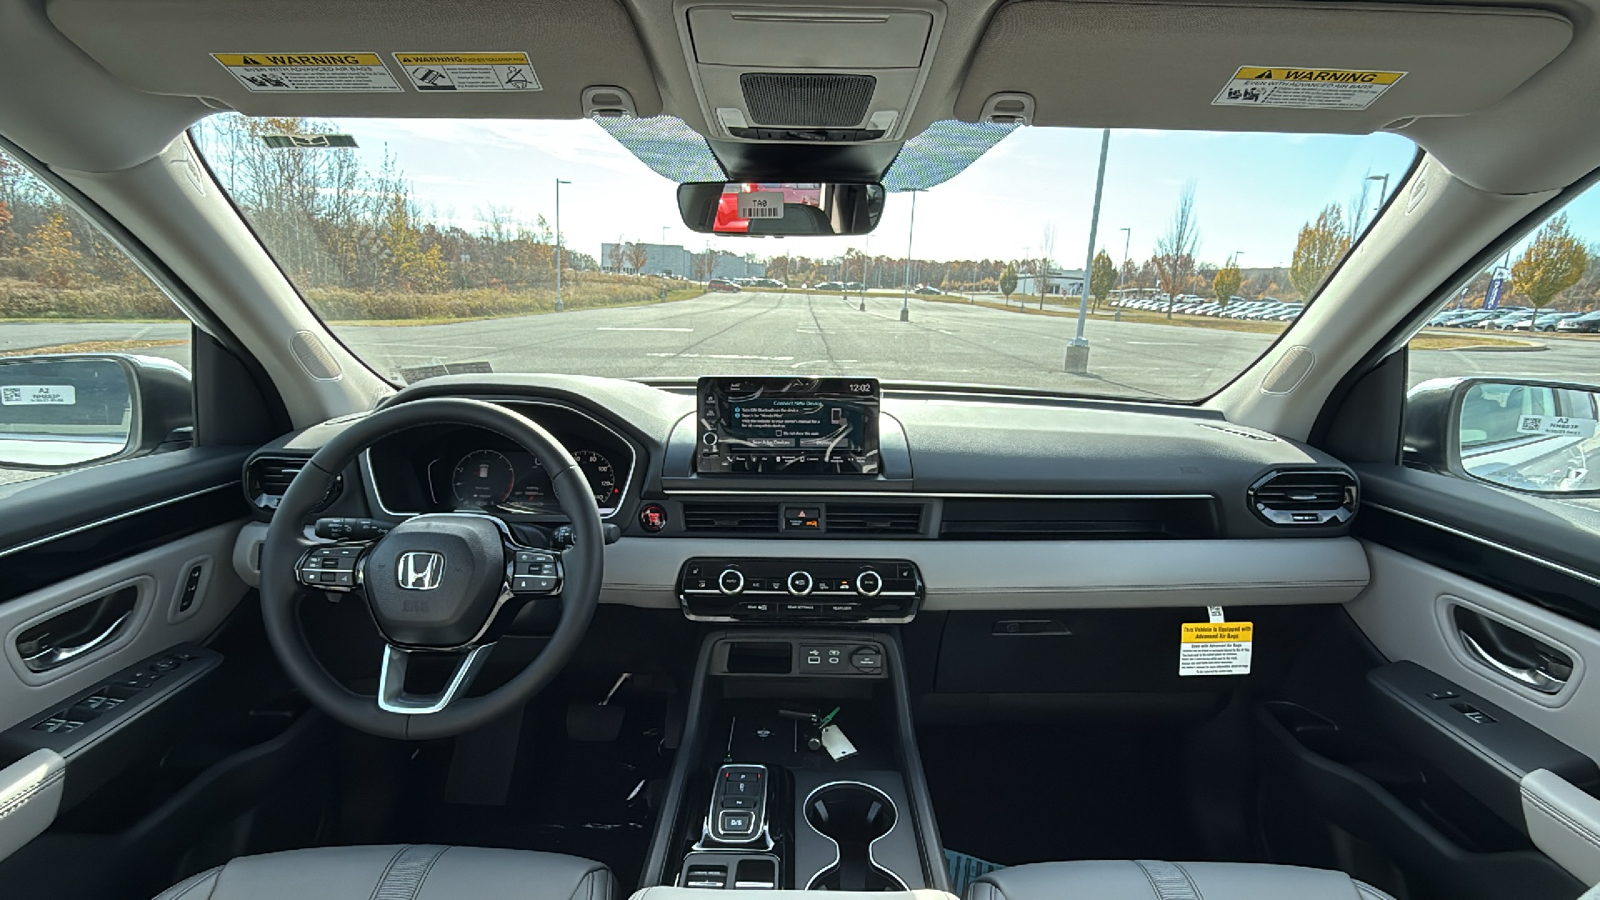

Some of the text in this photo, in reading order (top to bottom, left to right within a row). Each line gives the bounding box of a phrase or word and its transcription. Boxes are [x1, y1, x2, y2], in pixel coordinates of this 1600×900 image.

[265, 55, 360, 65] WARNING
[1284, 69, 1378, 82] WARNING
[849, 383, 871, 392] 12:02
